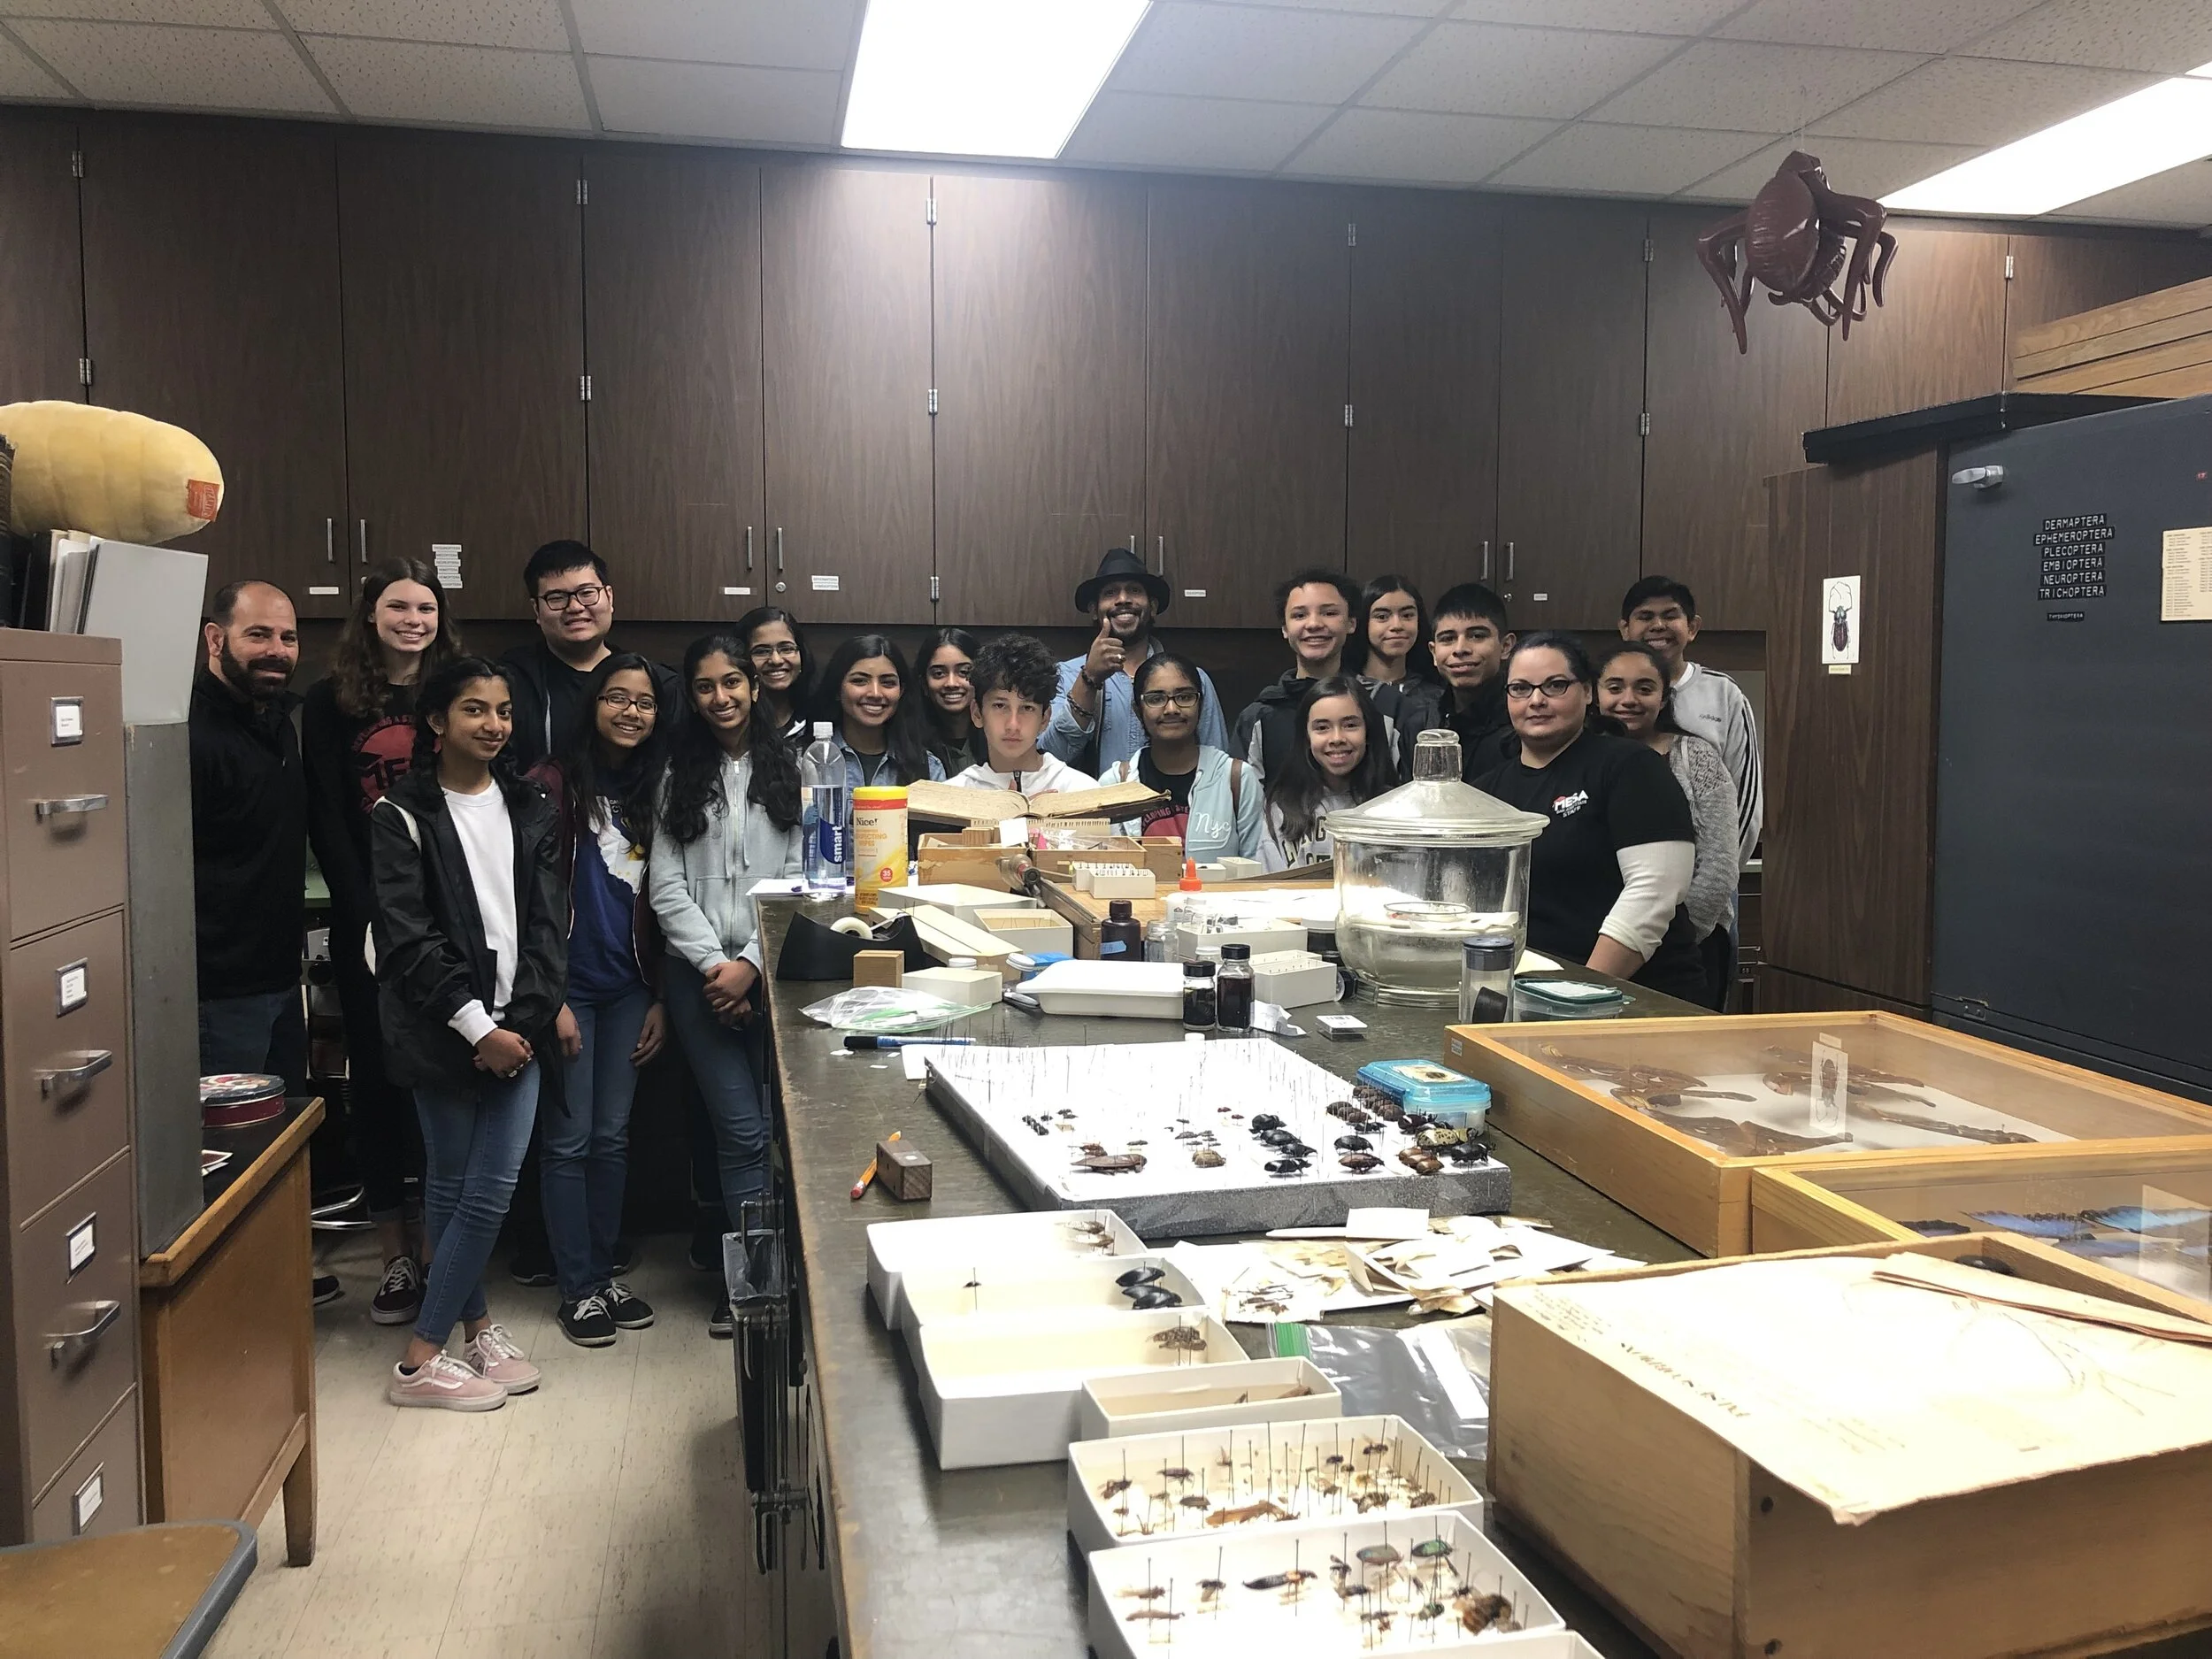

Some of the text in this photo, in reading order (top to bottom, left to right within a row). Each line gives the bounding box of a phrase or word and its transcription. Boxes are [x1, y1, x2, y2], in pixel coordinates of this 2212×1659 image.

[2045, 514, 2105, 530] DERMAPTERA
[2035, 527, 2113, 544] EPHEMEROPTERA
[2044, 542, 2103, 557] PLECOPTERA
[2043, 557, 2102, 572] EMBIOPTERA
[2043, 572, 2103, 585] NEUROPTERA
[2039, 586, 2105, 599] TRICHOPTERA
[1553, 789, 1589, 811] MESA
[1563, 805, 1581, 818] STAFF
[856, 817, 879, 826] Nice!
[832, 825, 842, 863] smart
